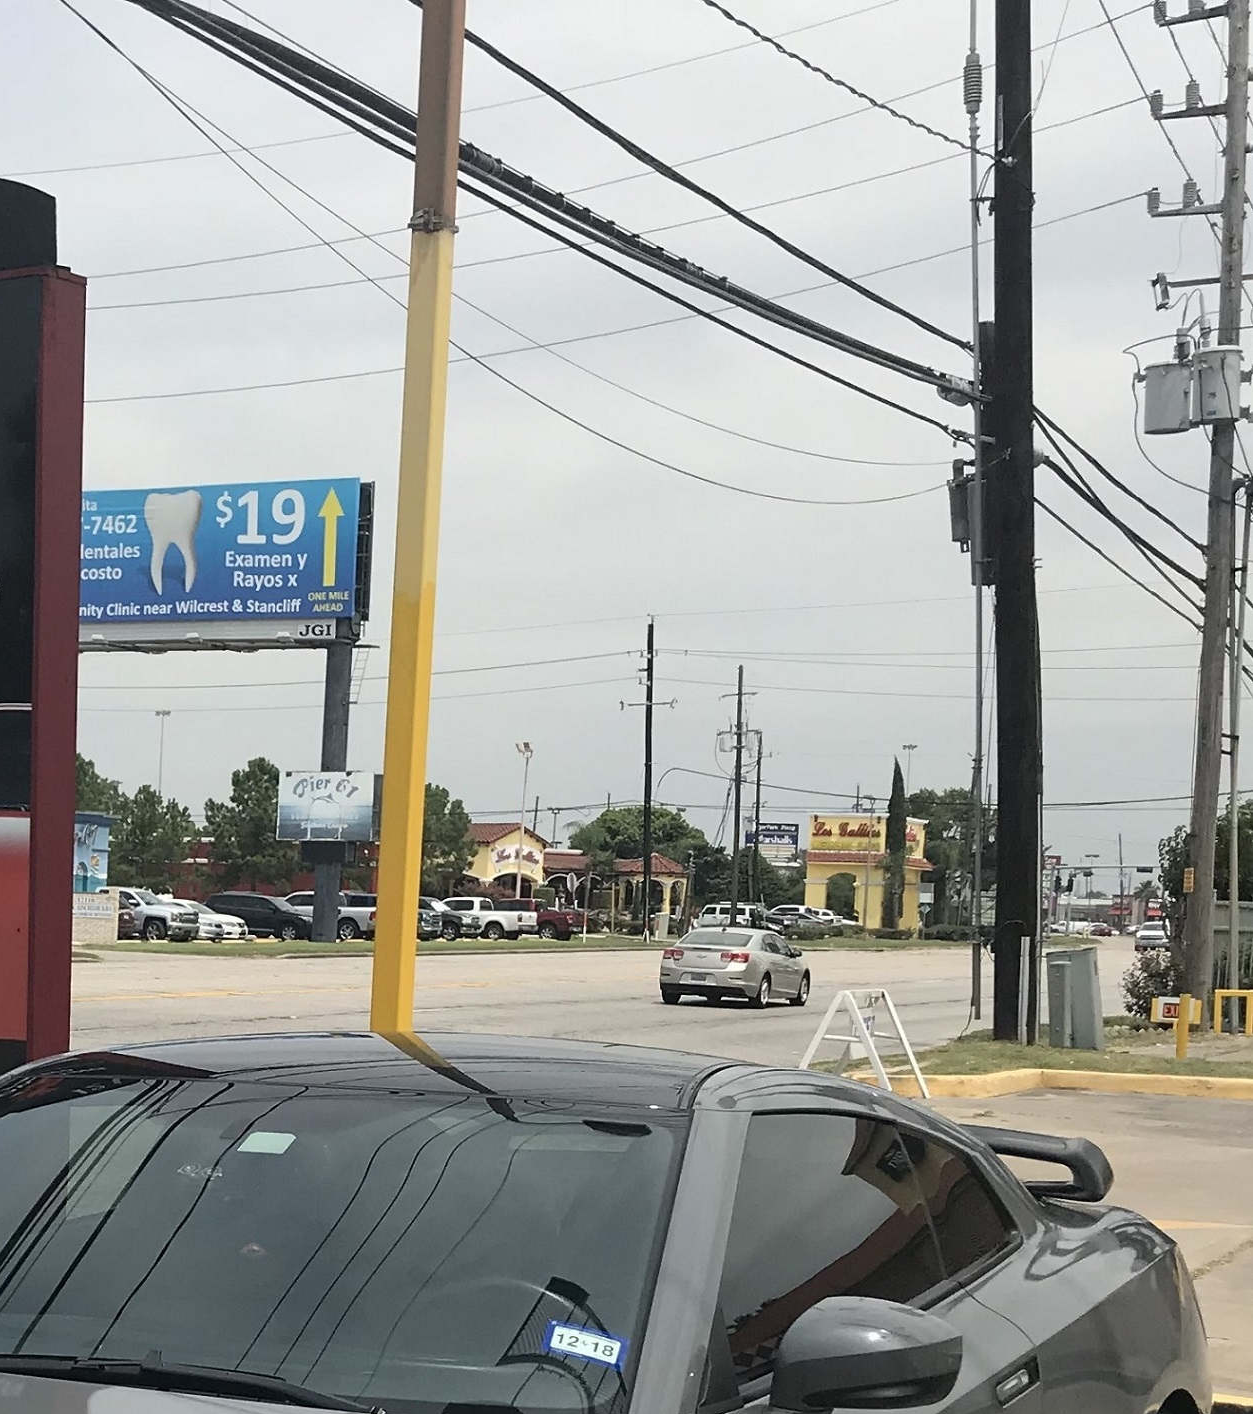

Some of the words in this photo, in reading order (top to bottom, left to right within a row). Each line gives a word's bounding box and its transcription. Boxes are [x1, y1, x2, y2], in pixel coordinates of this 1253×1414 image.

[81, 514, 137, 535] -7462
[216, 488, 306, 545] $19
[225, 551, 292, 567] Examen
[297, 553, 308, 570] y
[80, 566, 122, 580] costo
[233, 571, 283, 591] Rayos
[307, 592, 327, 601] ONE
[328, 591, 350, 600] MILE
[106, 602, 141, 617] Clinic
[143, 602, 173, 615] near
[176, 600, 228, 614] Wilcrest
[231, 599, 243, 613] &
[246, 598, 301, 613] Stancliff
[312, 602, 344, 612] AHEAD
[298, 624, 332, 637] JGI
[292, 776, 331, 798] Pier
[1164, 1004, 1179, 1017] EXI
